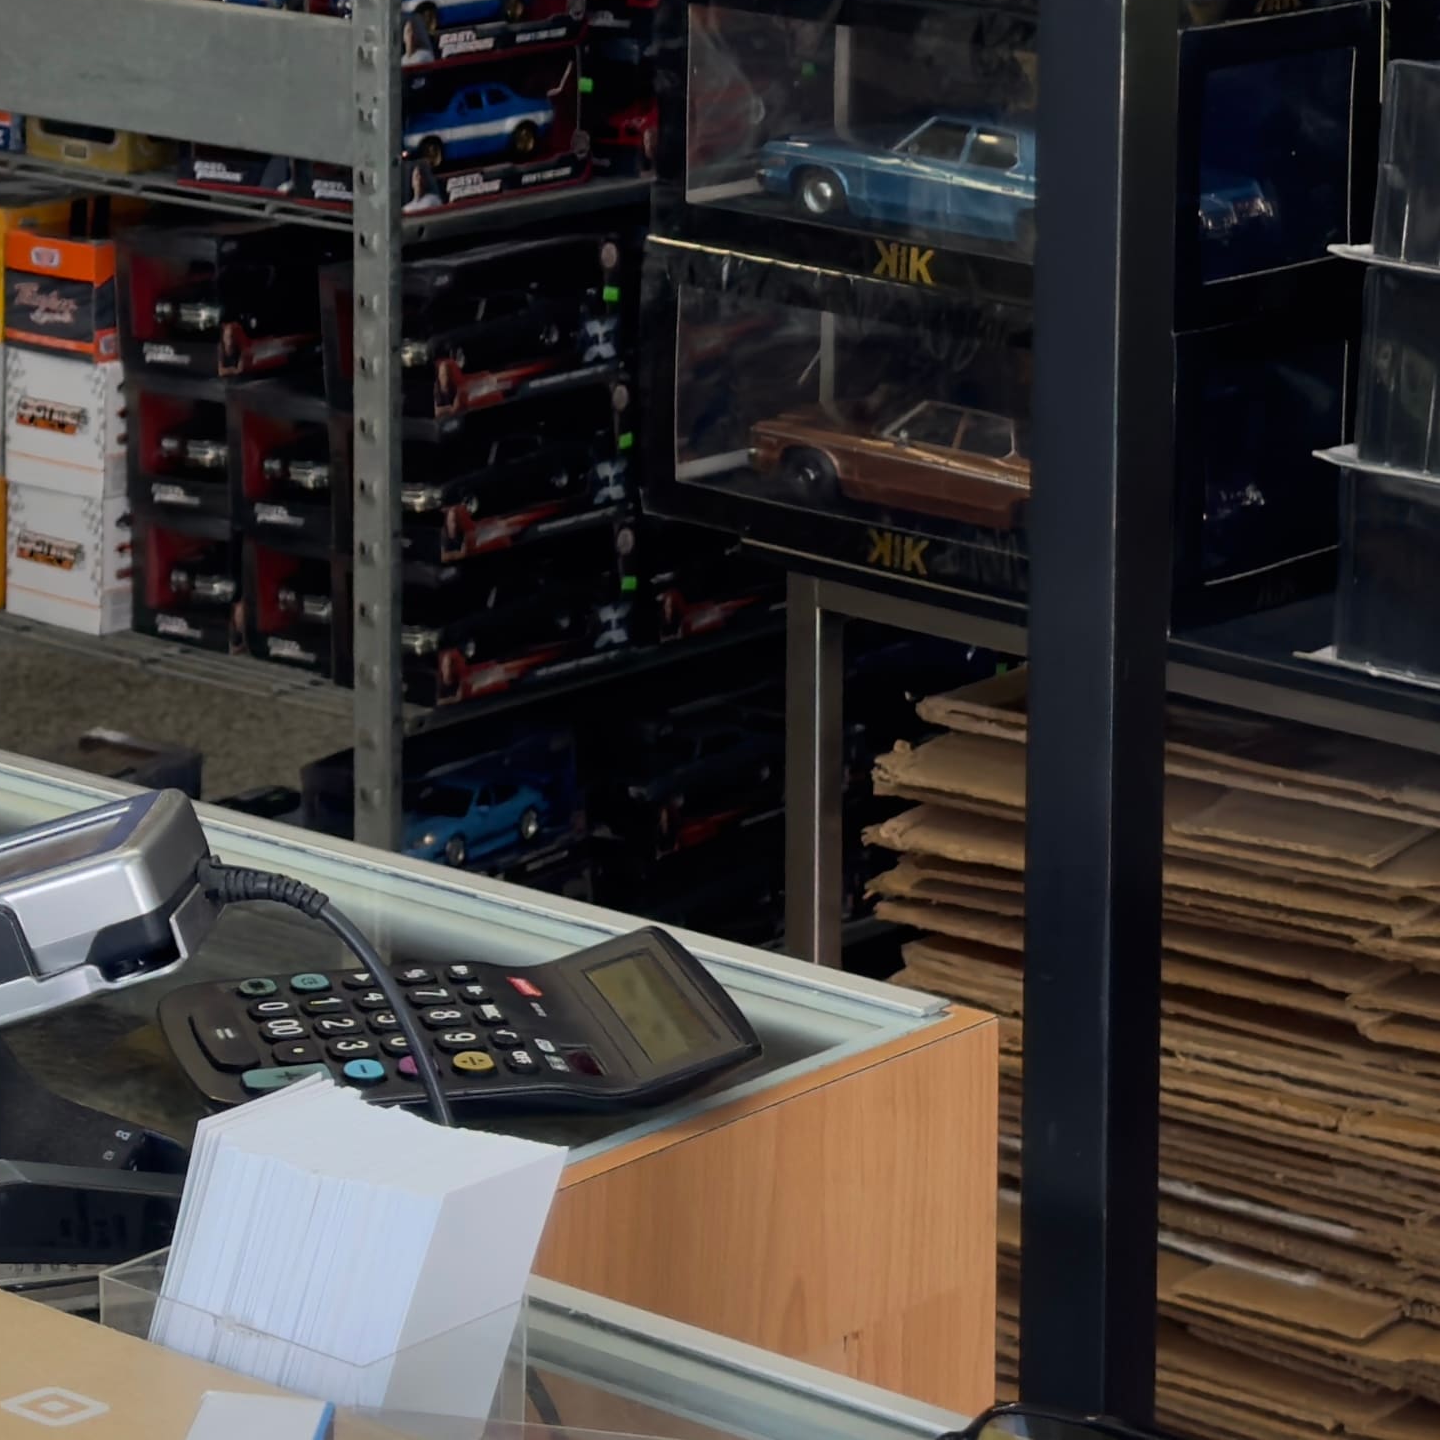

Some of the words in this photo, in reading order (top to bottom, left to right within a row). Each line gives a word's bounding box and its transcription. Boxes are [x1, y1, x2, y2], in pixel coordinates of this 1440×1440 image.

[415, 989, 448, 1000] 7
[429, 1009, 462, 1021] 8
[267, 1019, 305, 1036] 00
[322, 1017, 354, 1029] 2
[443, 1032, 477, 1045] 9
[337, 1040, 369, 1052] 3
